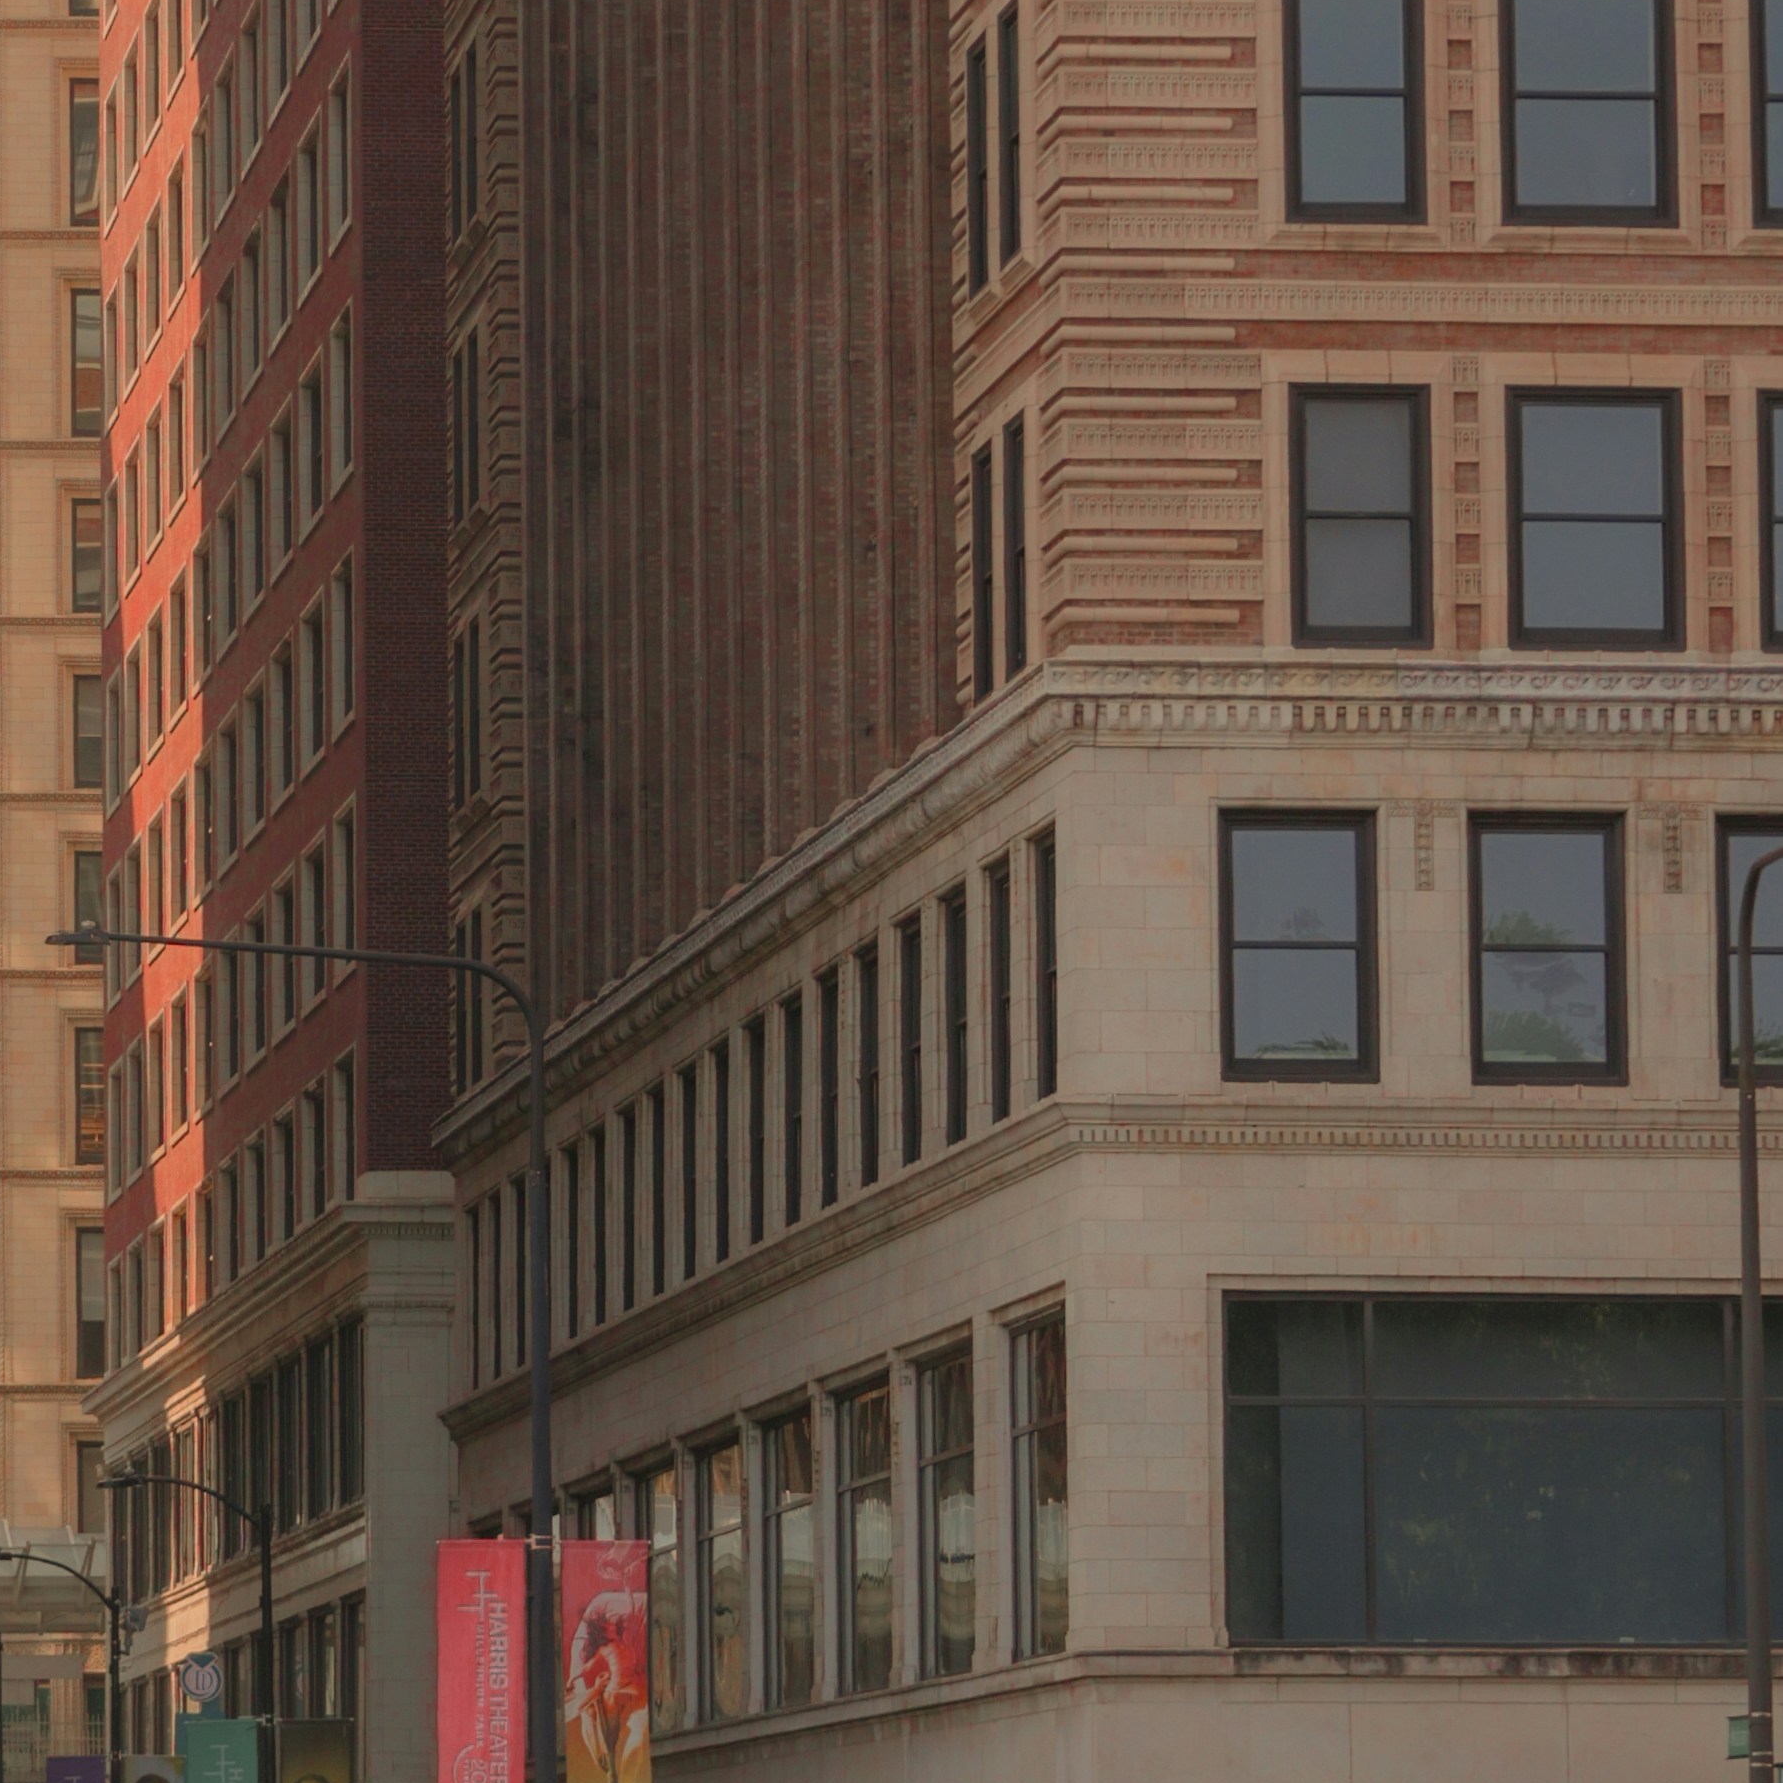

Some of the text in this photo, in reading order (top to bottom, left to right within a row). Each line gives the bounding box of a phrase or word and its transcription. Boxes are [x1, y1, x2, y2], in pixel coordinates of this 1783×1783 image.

[476, 1624, 484, 1747] MILLENNIUM PARK
[489, 1602, 507, 1690] HARRIS
